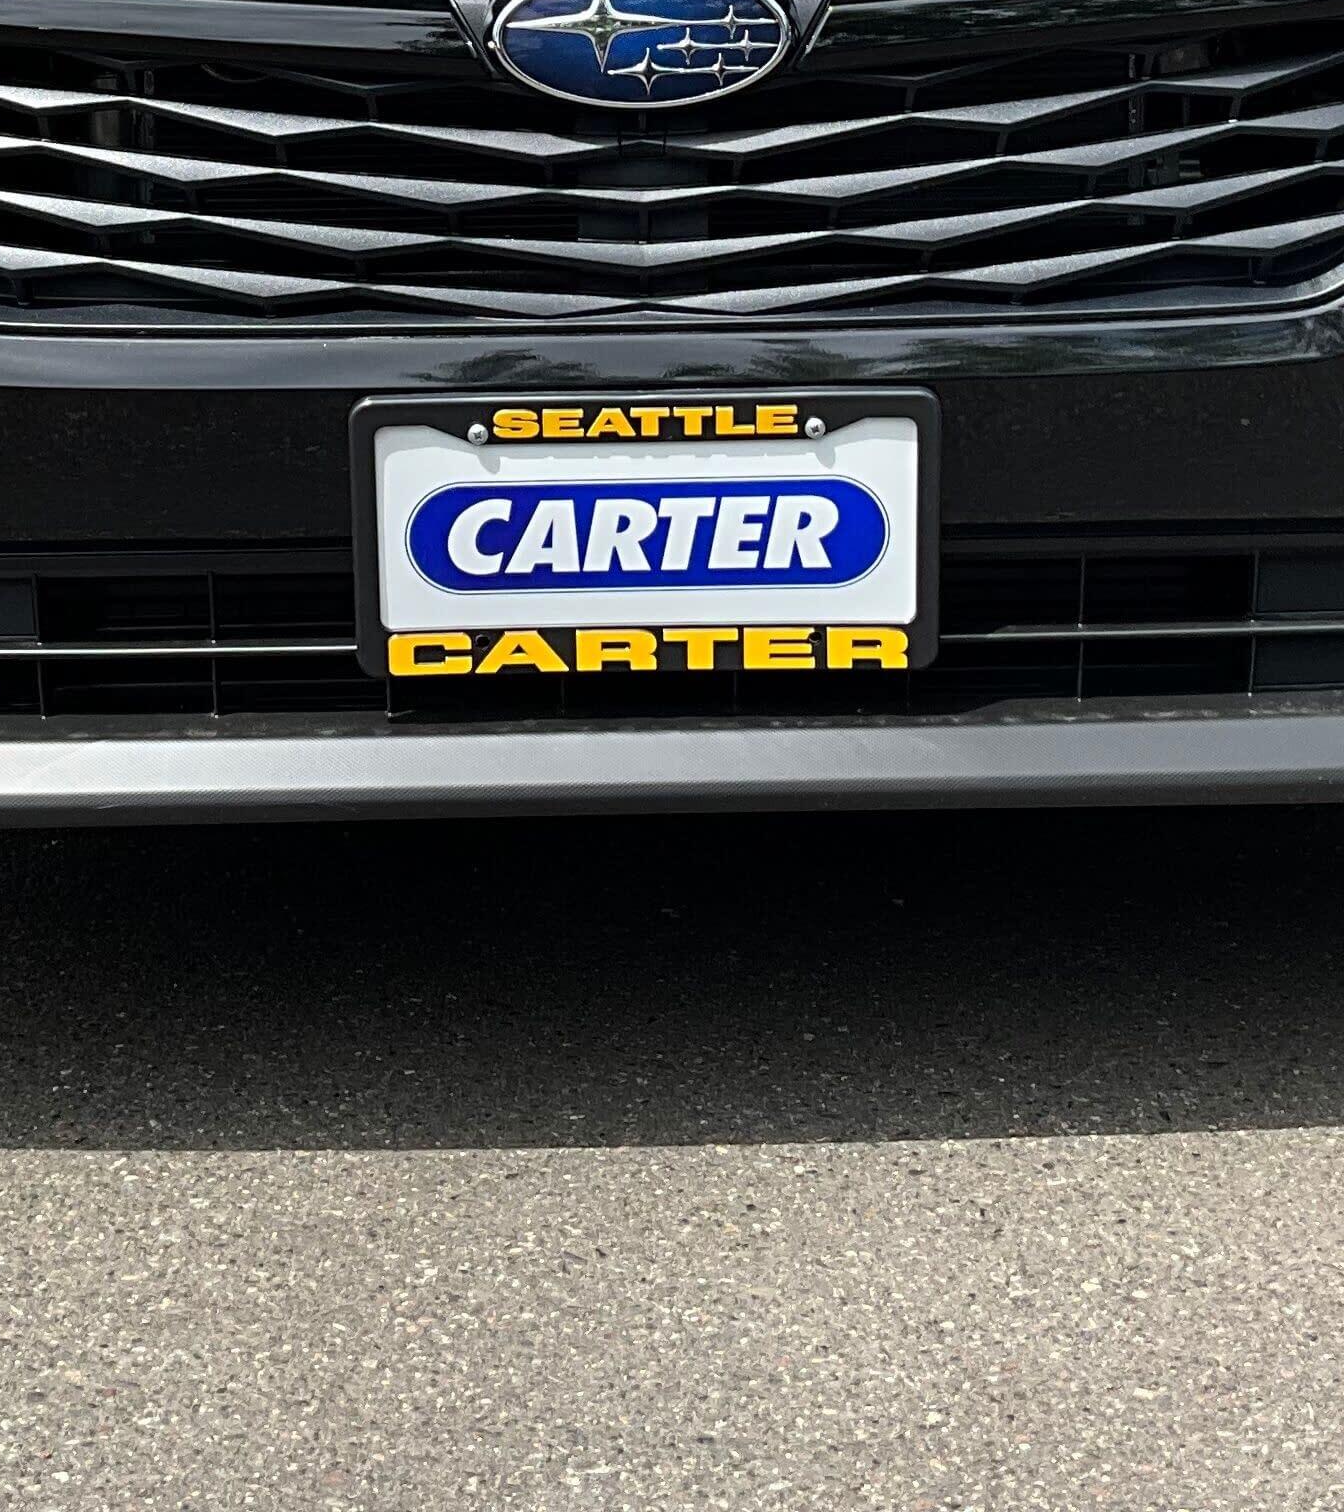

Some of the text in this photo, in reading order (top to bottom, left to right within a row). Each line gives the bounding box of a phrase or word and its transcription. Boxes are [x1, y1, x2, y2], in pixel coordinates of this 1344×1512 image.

[493, 404, 798, 438] SEATTLE
[447, 496, 839, 575] CARTER
[387, 627, 909, 676] CARTER
